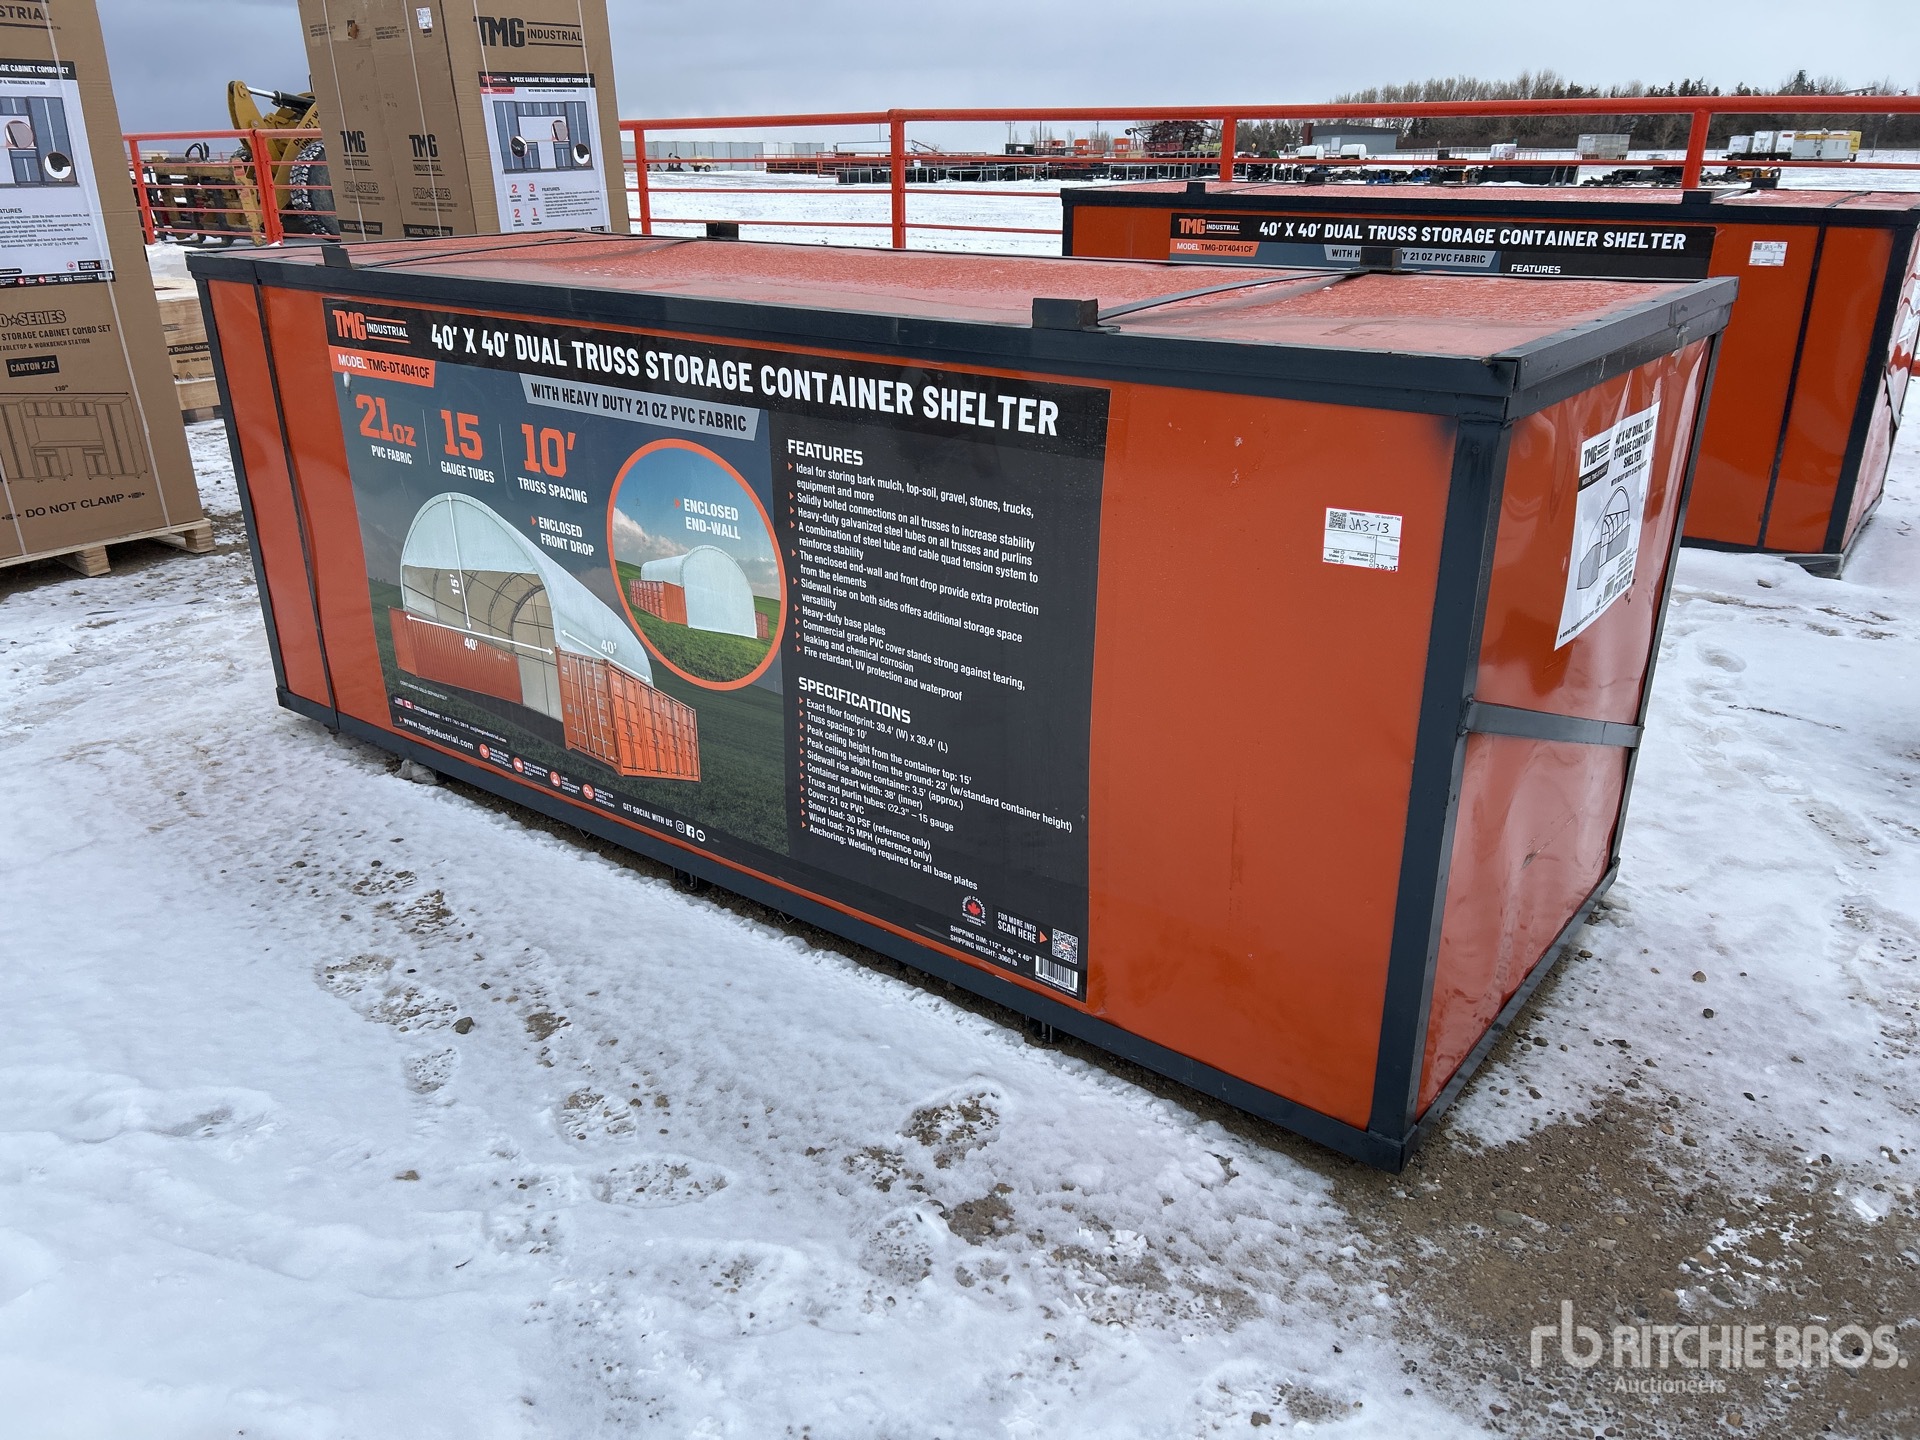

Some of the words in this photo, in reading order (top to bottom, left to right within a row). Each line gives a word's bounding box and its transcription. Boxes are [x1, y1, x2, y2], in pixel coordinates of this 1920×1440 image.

[473, 15, 525, 47] TMG
[527, 28, 583, 41] INDUSTRIAL
[10, 64, 35, 73] CABINET
[37, 66, 57, 74] COMBO
[340, 130, 367, 153] TMG
[409, 134, 438, 157] TMG
[344, 159, 370, 167] INDUSTRIAL
[413, 164, 442, 172] INDUSTRIAL
[511, 184, 518, 193] 2
[529, 183, 535, 192] 3
[514, 209, 521, 218] 2
[533, 207, 538, 217] 1
[1178, 218, 1205, 235] TMG
[1206, 223, 1240, 231] INDUSTRIAL
[1259, 222, 1282, 236] 40'
[1284, 222, 1295, 237] X
[1298, 223, 1321, 238] 40'
[1324, 224, 1363, 240] DUAL
[1368, 225, 1417, 242] TRUSS
[1421, 227, 1496, 244] STORAGE
[1500, 229, 1599, 248] CONTAINER
[1603, 231, 1686, 250] SHELTER
[1176, 242, 1200, 251] MODEL
[1200, 243, 1253, 253] TMG-DT4041CF
[1331, 248, 1353, 258] WITH
[1410, 252, 1419, 261] 21
[1421, 252, 1432, 261] OZ
[1435, 253, 1452, 262] PVC
[1454, 253, 1486, 263] FABRIC
[1510, 264, 1561, 274] FEATURES
[17, 310, 67, 326] SERIES
[333, 310, 366, 339] TMG
[366, 322, 408, 337] INDUSTRIAL
[1, 330, 37, 341] STORAGE
[38, 328, 70, 338] CABINET
[72, 326, 97, 335] COMBO
[97, 324, 111, 333] SET
[34, 340, 67, 349] WORKBENCH
[10, 362, 40, 372] CARTON
[42, 360, 56, 370] 2/3
[337, 353, 367, 369] MODEL
[367, 358, 430, 379] TMG-DT4041CF
[431, 323, 457, 351] 40'
[462, 327, 477, 354] X
[481, 329, 509, 358] 40'
[514, 333, 567, 366] DUAL
[571, 340, 639, 376] TRUSS
[645, 350, 753, 393] STORAGE
[760, 364, 914, 415] CONTAINER
[922, 385, 1058, 436] SHELTER
[530, 382, 559, 401] WITH
[561, 387, 598, 407] HEAVY
[602, 393, 632, 413] DUTY
[635, 399, 648, 416] 21
[651, 402, 667, 419] OZ
[670, 404, 695, 423] PVC
[698, 409, 746, 431] FABRIC
[441, 410, 482, 459] 15
[370, 444, 386, 458] PVC
[386, 448, 412, 464] FABRIC
[521, 424, 577, 478] 10'
[787, 438, 863, 466] FEATURES
[1584, 444, 1598, 468] TMG
[440, 460, 467, 477] GAUGE
[467, 466, 494, 483] TUBES
[517, 476, 546, 494] TRUSS
[548, 483, 587, 503] SPACING
[795, 462, 814, 476] Ideal
[815, 466, 826, 478] for
[827, 469, 855, 485] storing
[856, 473, 876, 487] bark
[877, 478, 904, 493] mulch,
[906, 482, 938, 500] top-soil,
[940, 490, 968, 506] gravel,
[969, 495, 1000, 513] stones,
[1002, 500, 1034, 519] trucks,
[796, 479, 836, 495] equipment
[837, 487, 852, 498] and
[853, 490, 874, 502] more
[25, 507, 48, 519] DO
[50, 502, 76, 514] NOT
[81, 493, 125, 509] CLAMP
[683, 498, 738, 521] ENCLOSED
[538, 516, 582, 538] ENCLOSED
[685, 516, 741, 540] END-WALL
[1349, 517, 1389, 534] JA3-13
[540, 532, 567, 550] FRONT
[569, 539, 594, 556] DROP
[802, 605, 842, 626] Heavy-duty
[843, 615, 862, 629] base
[863, 621, 885, 636] plates
[464, 637, 479, 651] 40'
[601, 640, 618, 655] 40'
[803, 645, 817, 658] Fire
[818, 652, 854, 669] retardant,
[855, 659, 865, 671] UV
[866, 665, 902, 683] protection
[903, 677, 918, 688] and
[919, 681, 962, 701] waterproof
[798, 676, 911, 724] SPECIFICATIONS
[402, 717, 473, 750] www.tmgindustrial.com
[806, 710, 826, 725] Truss
[826, 719, 855, 737] spacing:
[856, 728, 867, 739] 10'
[806, 698, 825, 712] Exact
[826, 704, 842, 717] floor
[843, 710, 875, 729] footprint:
[876, 721, 893, 735] 39.4'
[895, 727, 908, 742] (W)
[910, 733, 915, 742] x
[916, 734, 935, 747] 39.4'
[937, 740, 948, 754] (L)
[807, 787, 829, 803] Cover:
[829, 795, 838, 806] 21
[839, 800, 849, 810] oz
[849, 802, 864, 815] PVC
[622, 802, 631, 812] GET
[632, 806, 651, 819] SOCIAL
[651, 812, 664, 824] WITH
[665, 817, 673, 827] US
[807, 799, 827, 813] Snow
[828, 806, 845, 820] load:
[846, 813, 856, 824] 30
[856, 816, 871, 828] PSF
[872, 822, 910, 842] (reference
[911, 836, 930, 851] only)
[997, 911, 1008, 921] FOR
[1008, 915, 1023, 928] MORE
[1024, 922, 1036, 933] INFO
[997, 920, 1016, 935] SCAN
[1017, 927, 1036, 944] HERE
